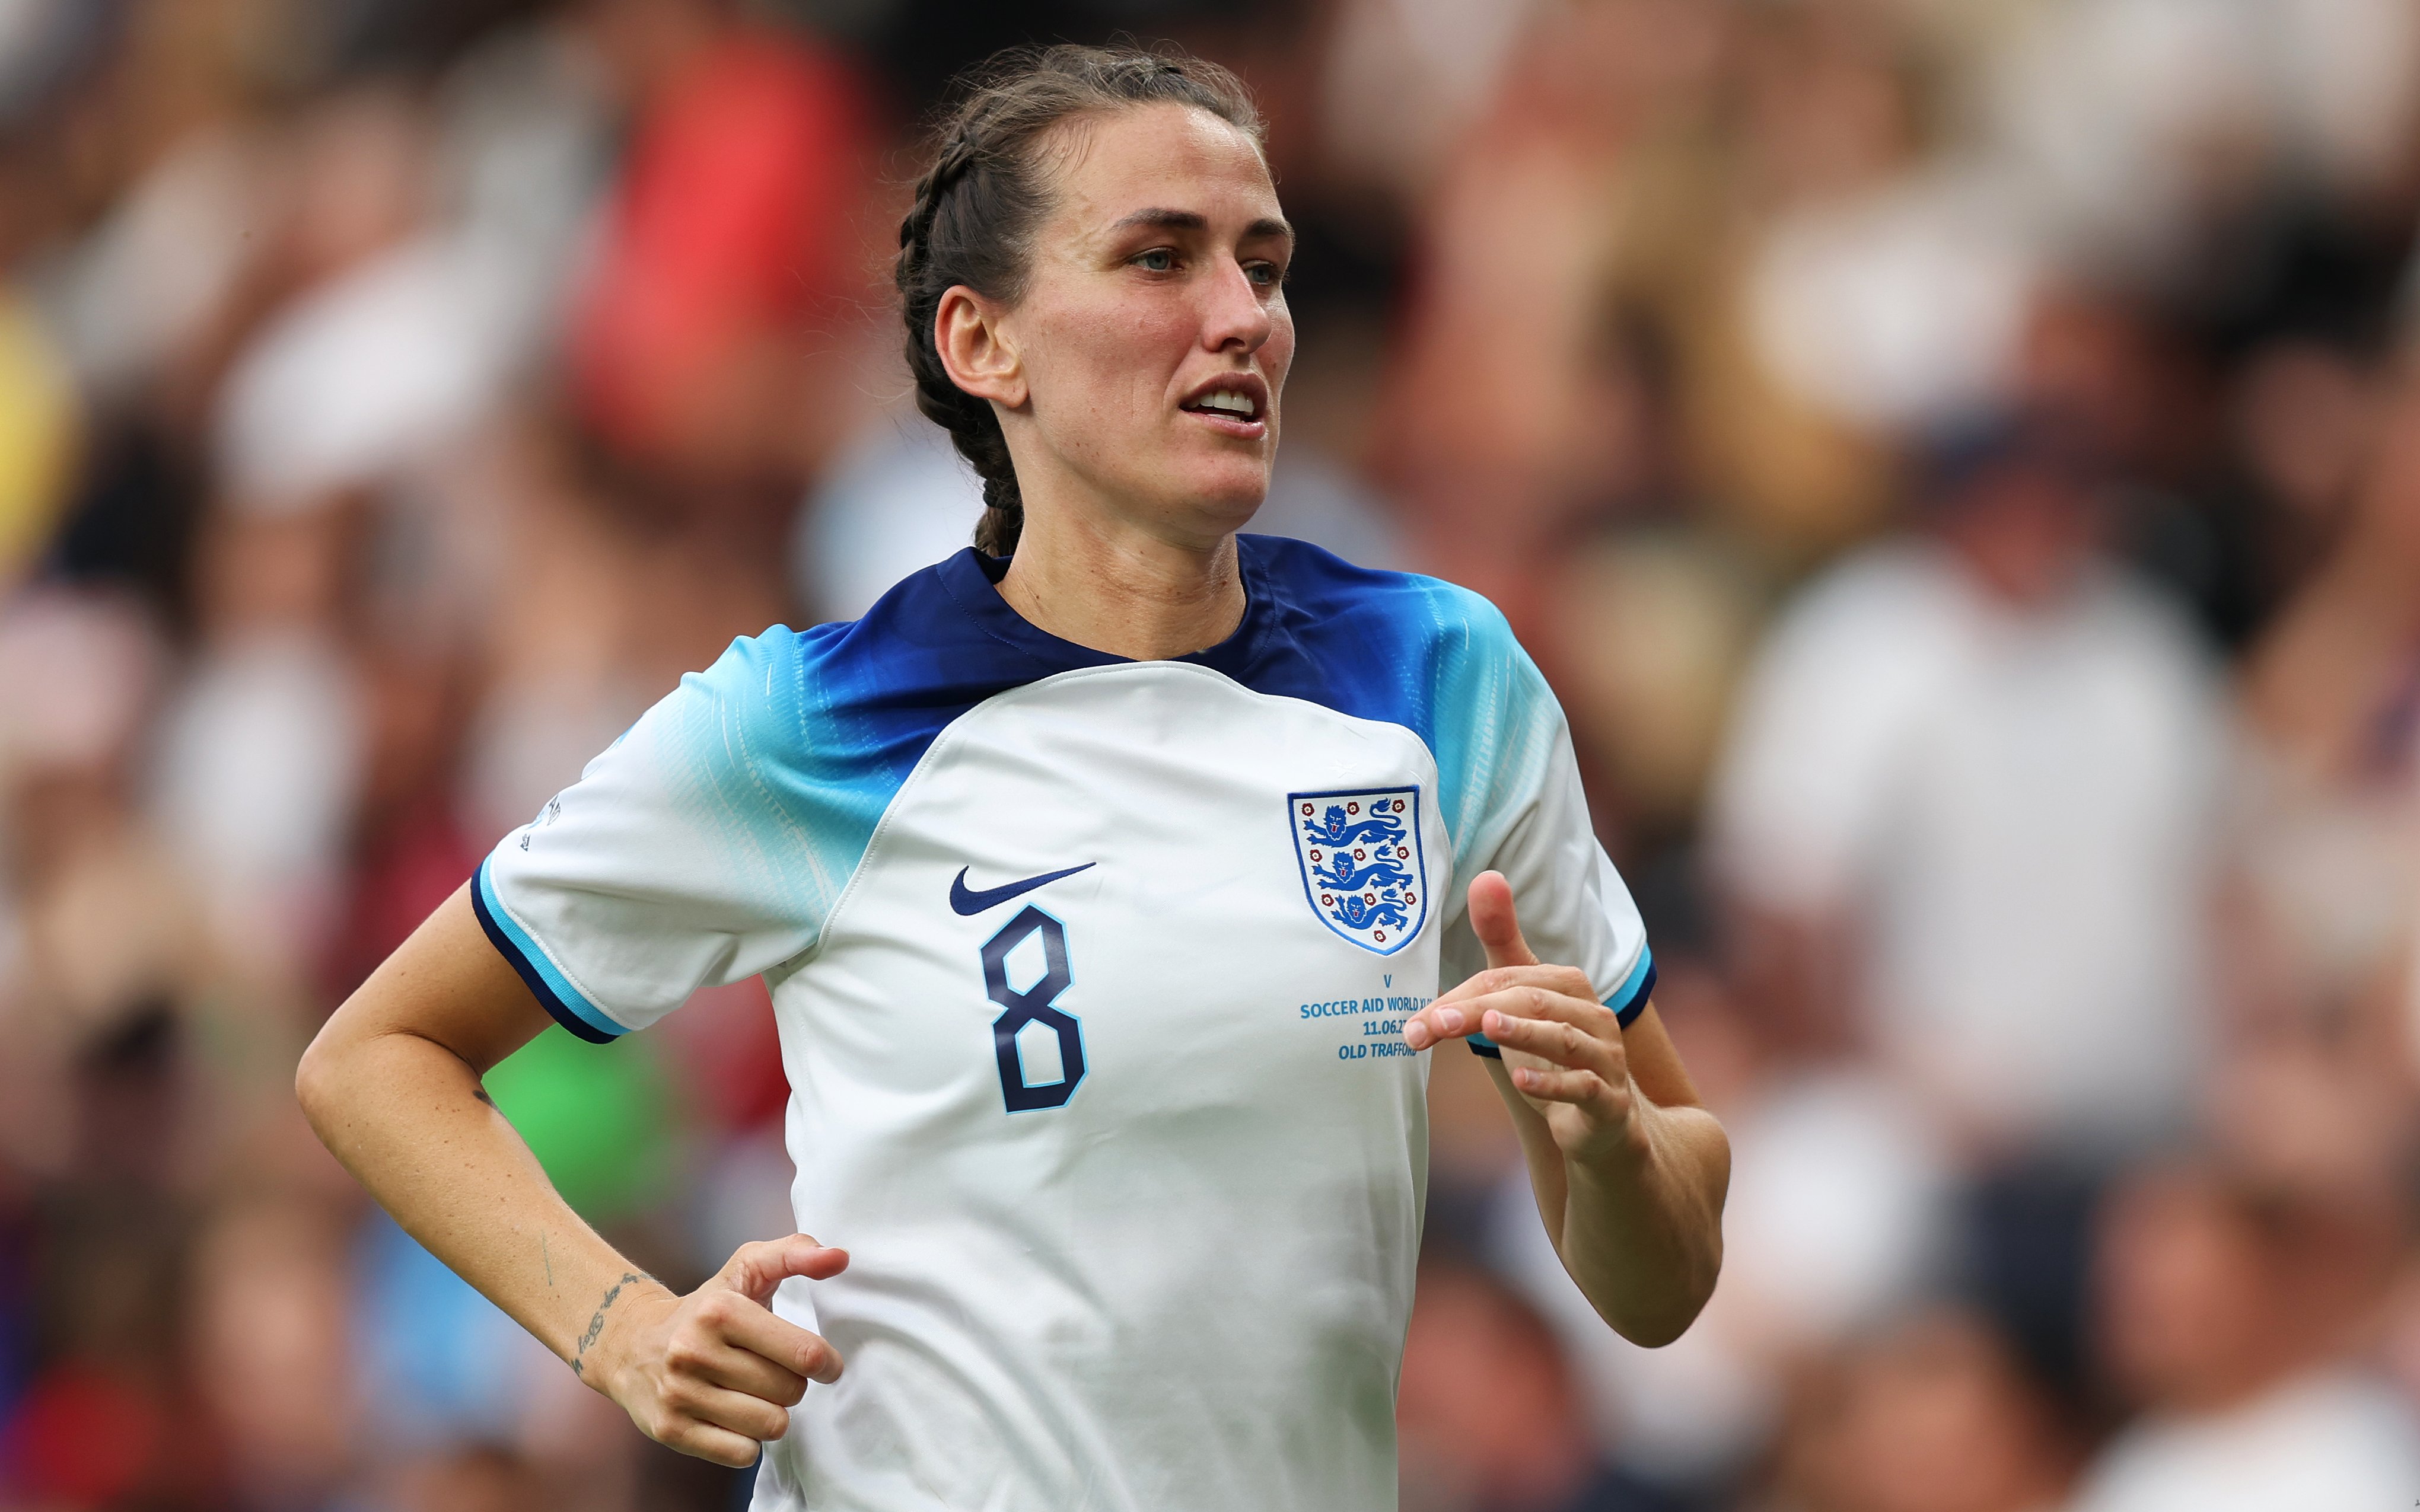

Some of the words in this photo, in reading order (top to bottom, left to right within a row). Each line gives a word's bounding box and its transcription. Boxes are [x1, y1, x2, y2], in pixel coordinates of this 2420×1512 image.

[1383, 974, 1392, 988] V
[977, 901, 1089, 1116] 8
[1301, 1000, 1358, 1019] SOCCER
[1362, 998, 1384, 1012] AID
[1387, 997, 1418, 1011] WORLD
[1363, 1020, 1407, 1035] 11.06.2
[1339, 1045, 1367, 1060] OLD
